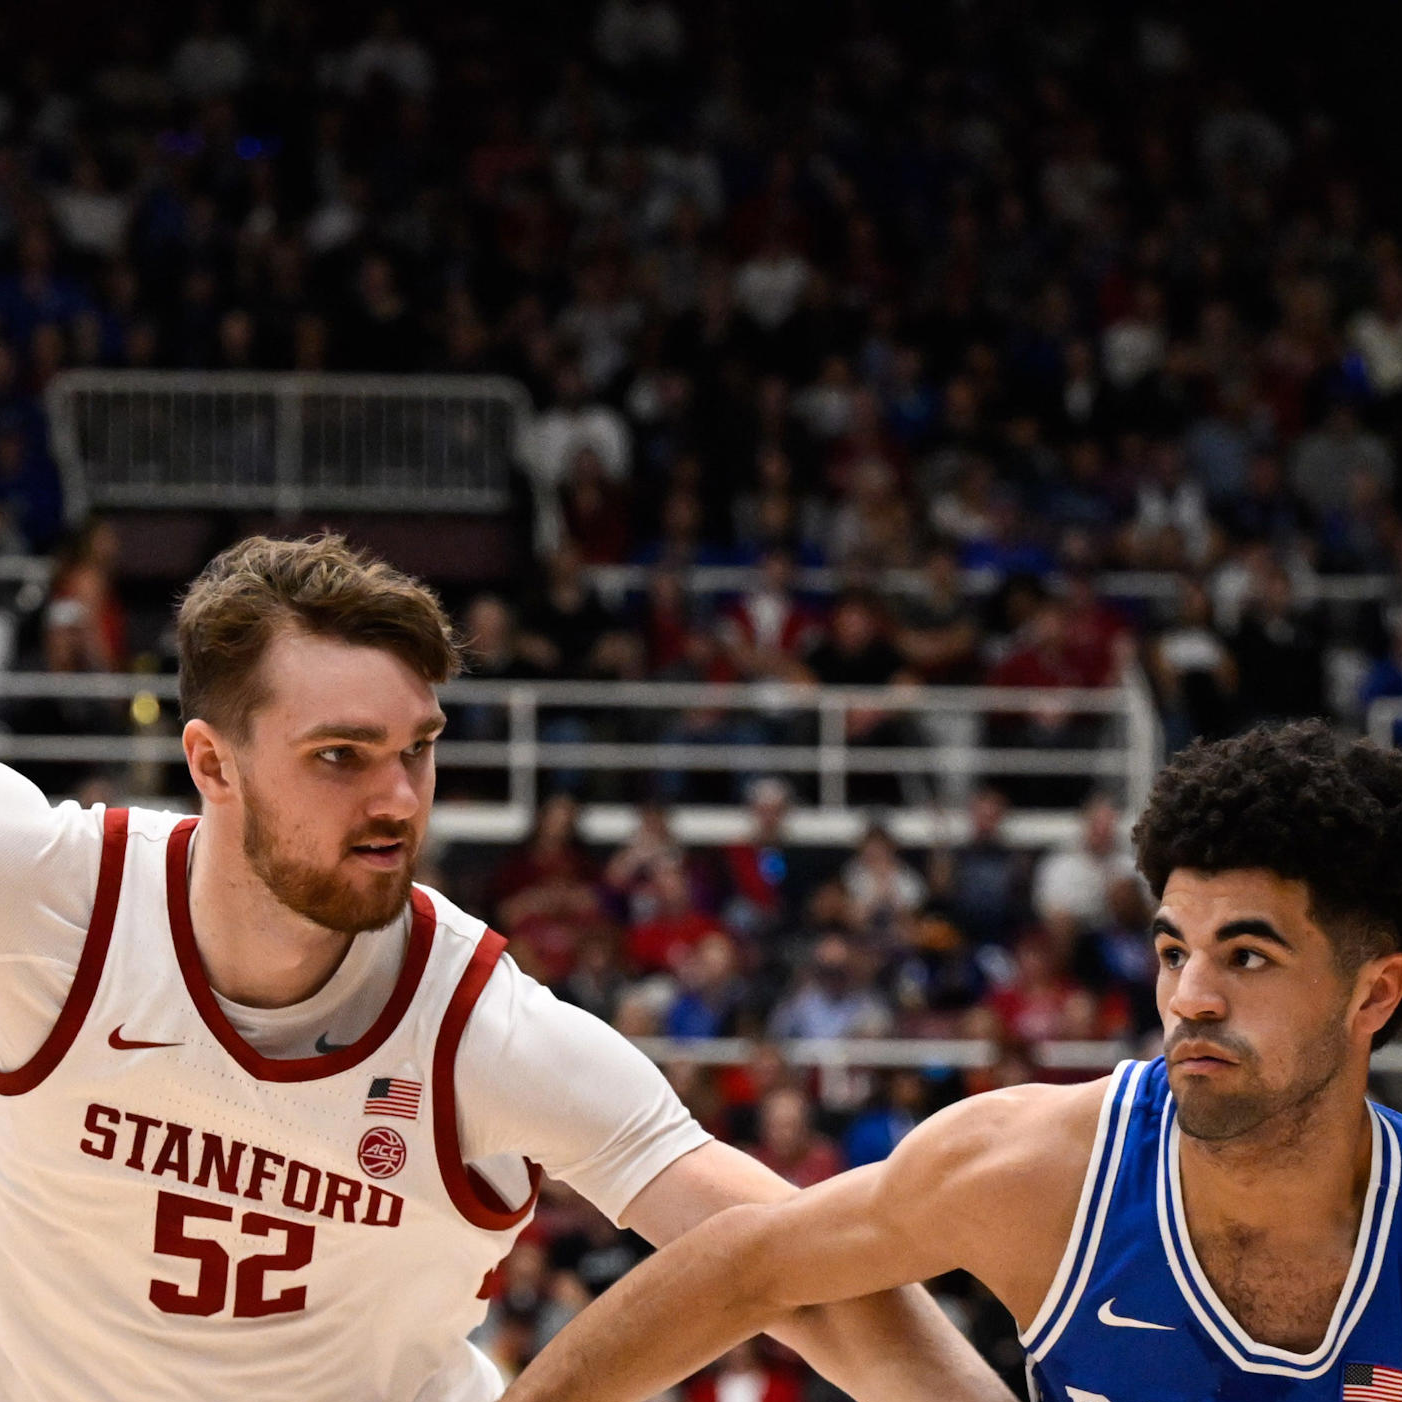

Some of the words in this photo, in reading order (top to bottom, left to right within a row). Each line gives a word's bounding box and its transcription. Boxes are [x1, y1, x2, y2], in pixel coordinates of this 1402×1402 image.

[79, 1103, 404, 1228] STANFORD
[364, 1144, 404, 1158] ACC
[149, 1190, 315, 1318] 52
